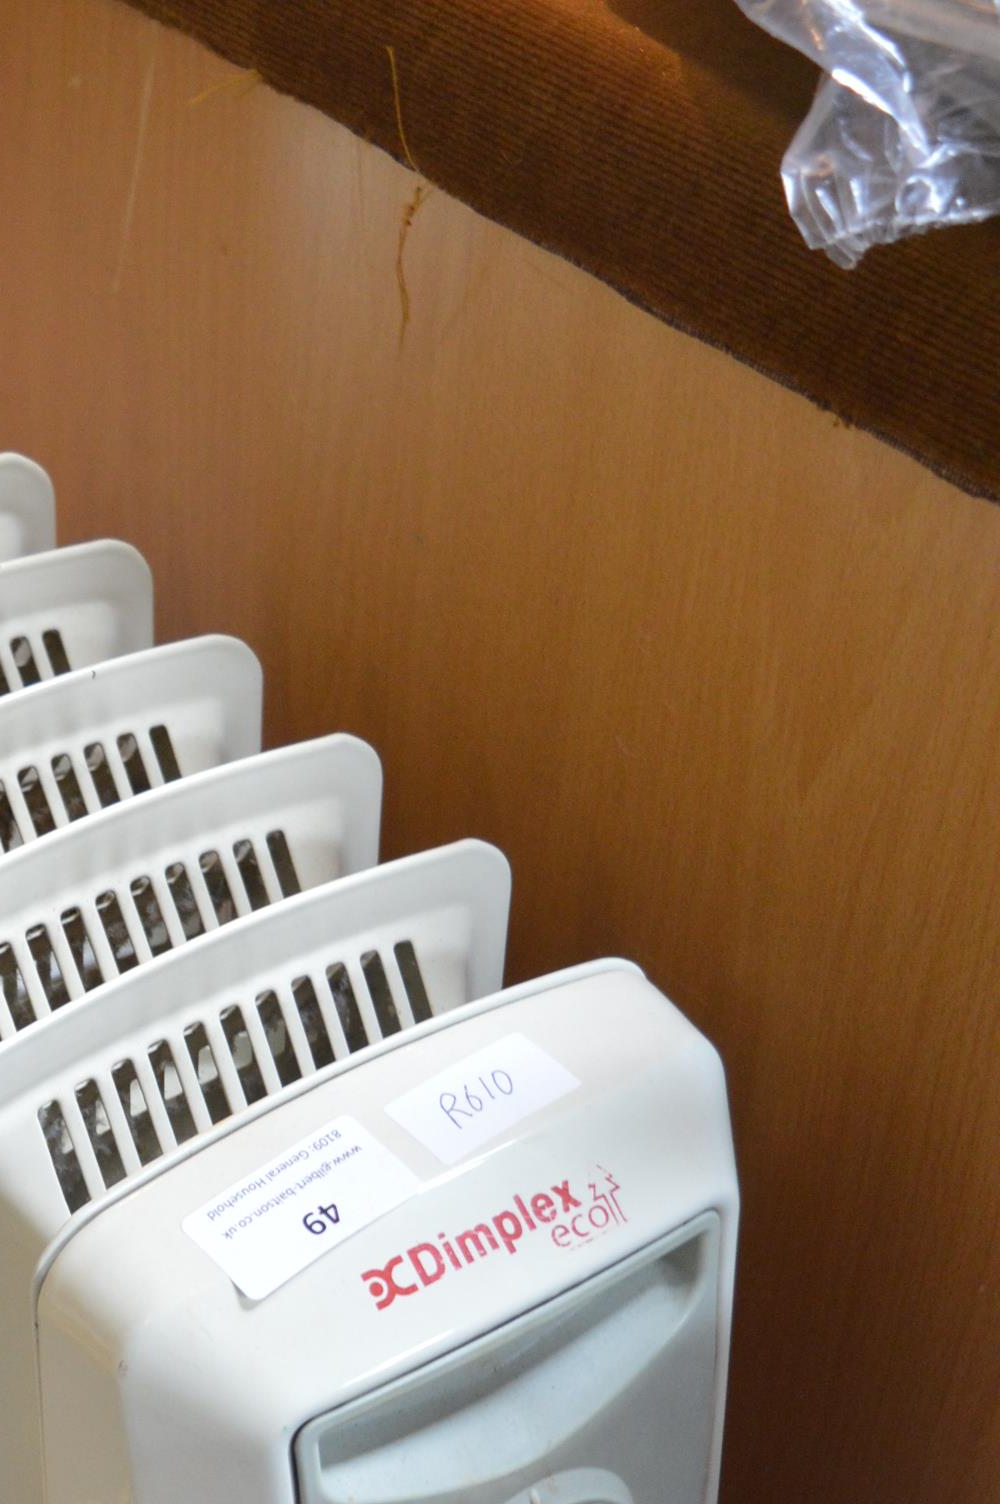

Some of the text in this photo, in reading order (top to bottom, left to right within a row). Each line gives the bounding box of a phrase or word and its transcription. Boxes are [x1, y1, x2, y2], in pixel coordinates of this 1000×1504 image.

[438, 1068, 515, 1130] R610
[265, 1149, 310, 1181] General
[206, 1179, 267, 1221] Household
[301, 1201, 341, 1237] 49
[406, 1178, 583, 1287] Dimplex
